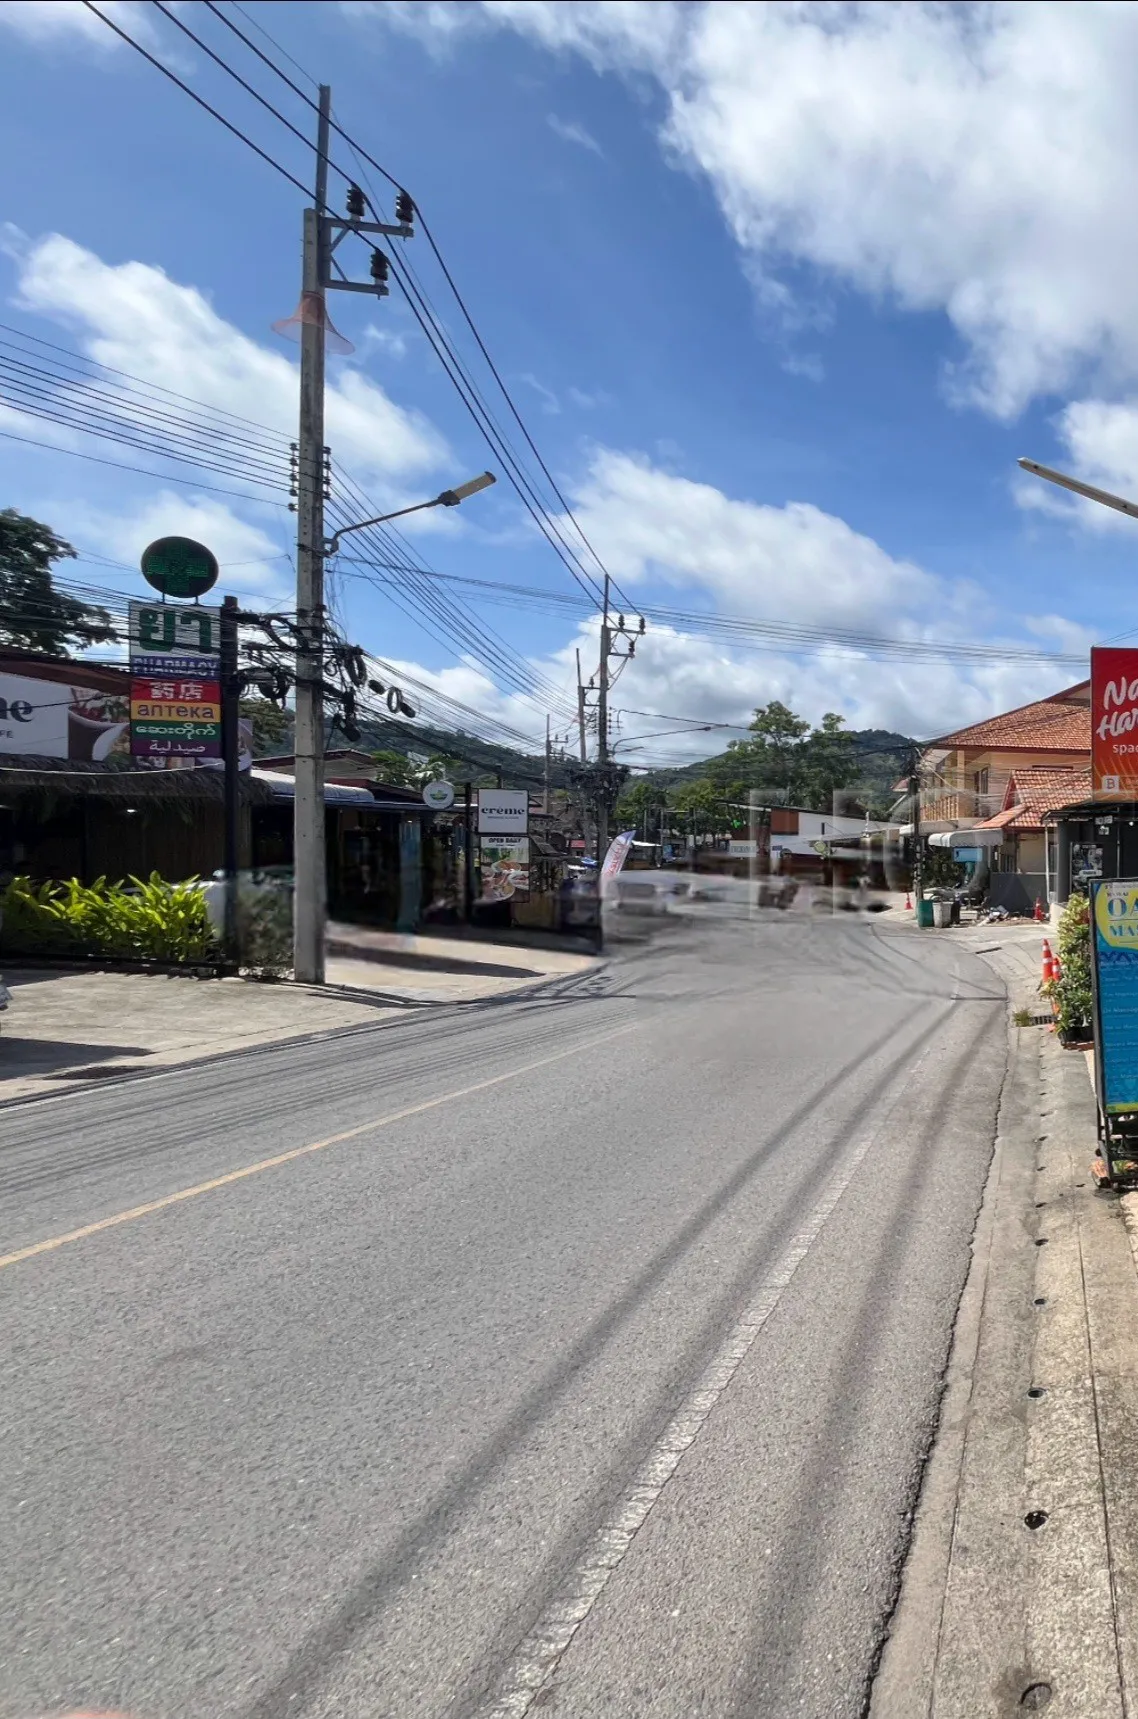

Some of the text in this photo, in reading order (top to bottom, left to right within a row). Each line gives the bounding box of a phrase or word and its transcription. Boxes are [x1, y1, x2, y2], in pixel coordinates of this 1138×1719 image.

[138, 608, 214, 653] ยา
[137, 703, 215, 719] аптека
[1106, 778, 1116, 790] B
